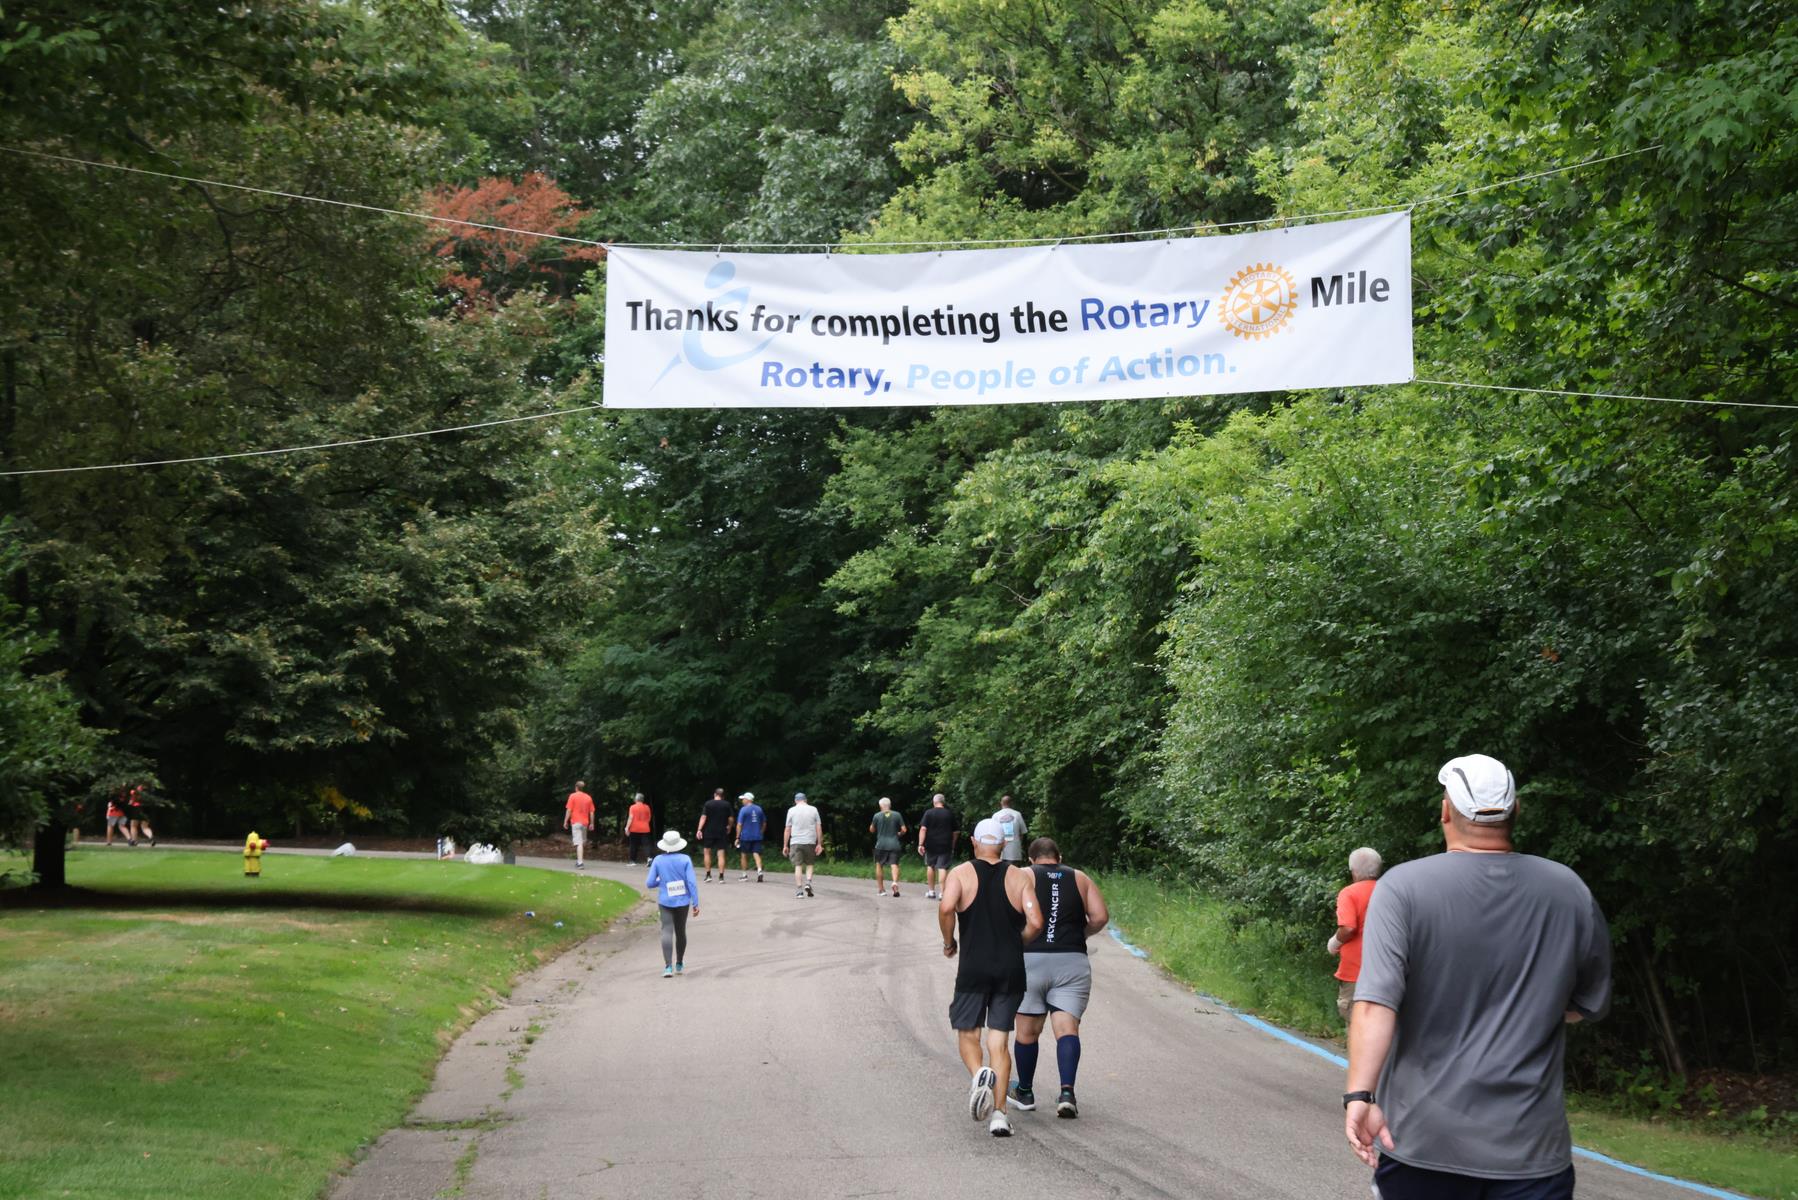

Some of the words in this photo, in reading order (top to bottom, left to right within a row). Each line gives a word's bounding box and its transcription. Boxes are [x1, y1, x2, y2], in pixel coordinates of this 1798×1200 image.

[1244, 272, 1277, 284] ROTARY
[625, 300, 739, 332] Thanks
[750, 304, 801, 333] for
[811, 305, 1001, 345] completing
[1009, 301, 1068, 334] the
[1079, 296, 1211, 332] Rotary
[1310, 271, 1390, 309] Mile
[760, 360, 893, 397] Rotary,
[906, 359, 1037, 396] People
[1048, 356, 1089, 387] of
[1098, 346, 1238, 385] Action.
